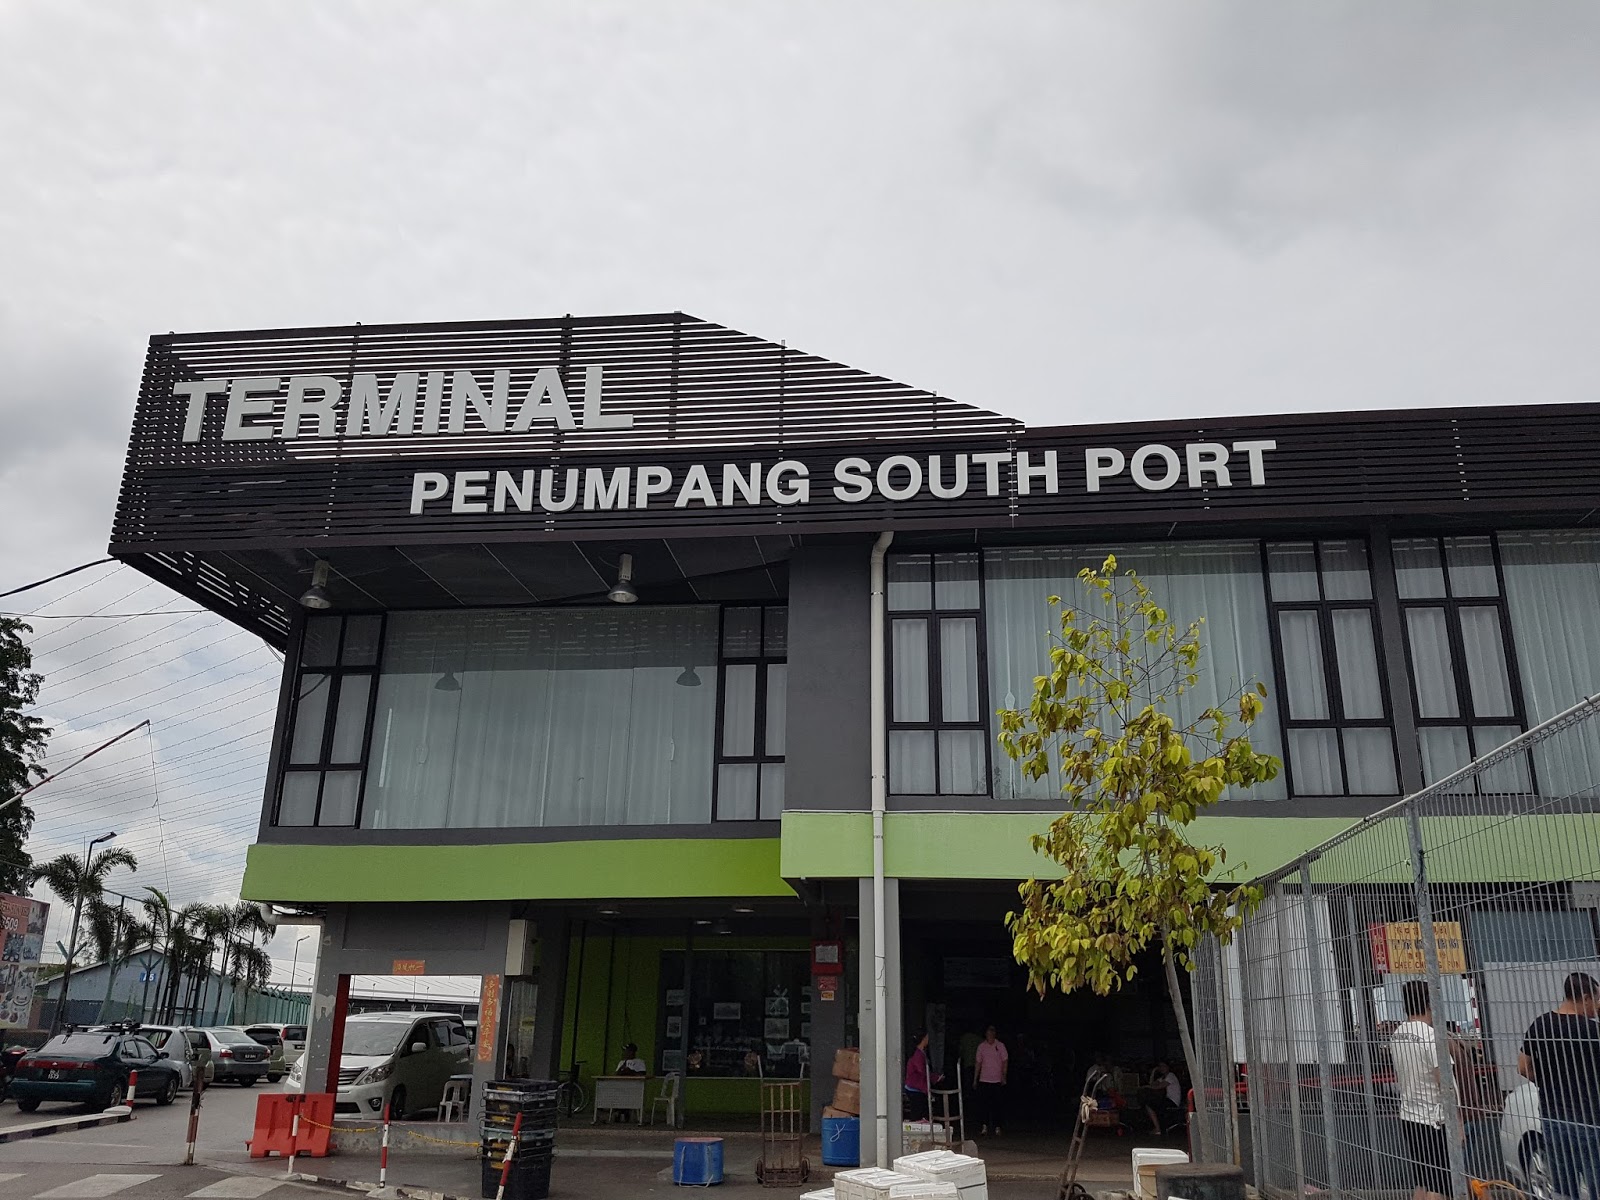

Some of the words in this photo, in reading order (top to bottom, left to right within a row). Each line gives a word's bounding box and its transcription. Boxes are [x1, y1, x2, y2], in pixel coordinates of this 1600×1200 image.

[173, 366, 635, 444] TERMINAL
[409, 460, 810, 515] PENUMPANG
[833, 451, 1060, 503] SOUTH
[1085, 440, 1278, 494] PORT
